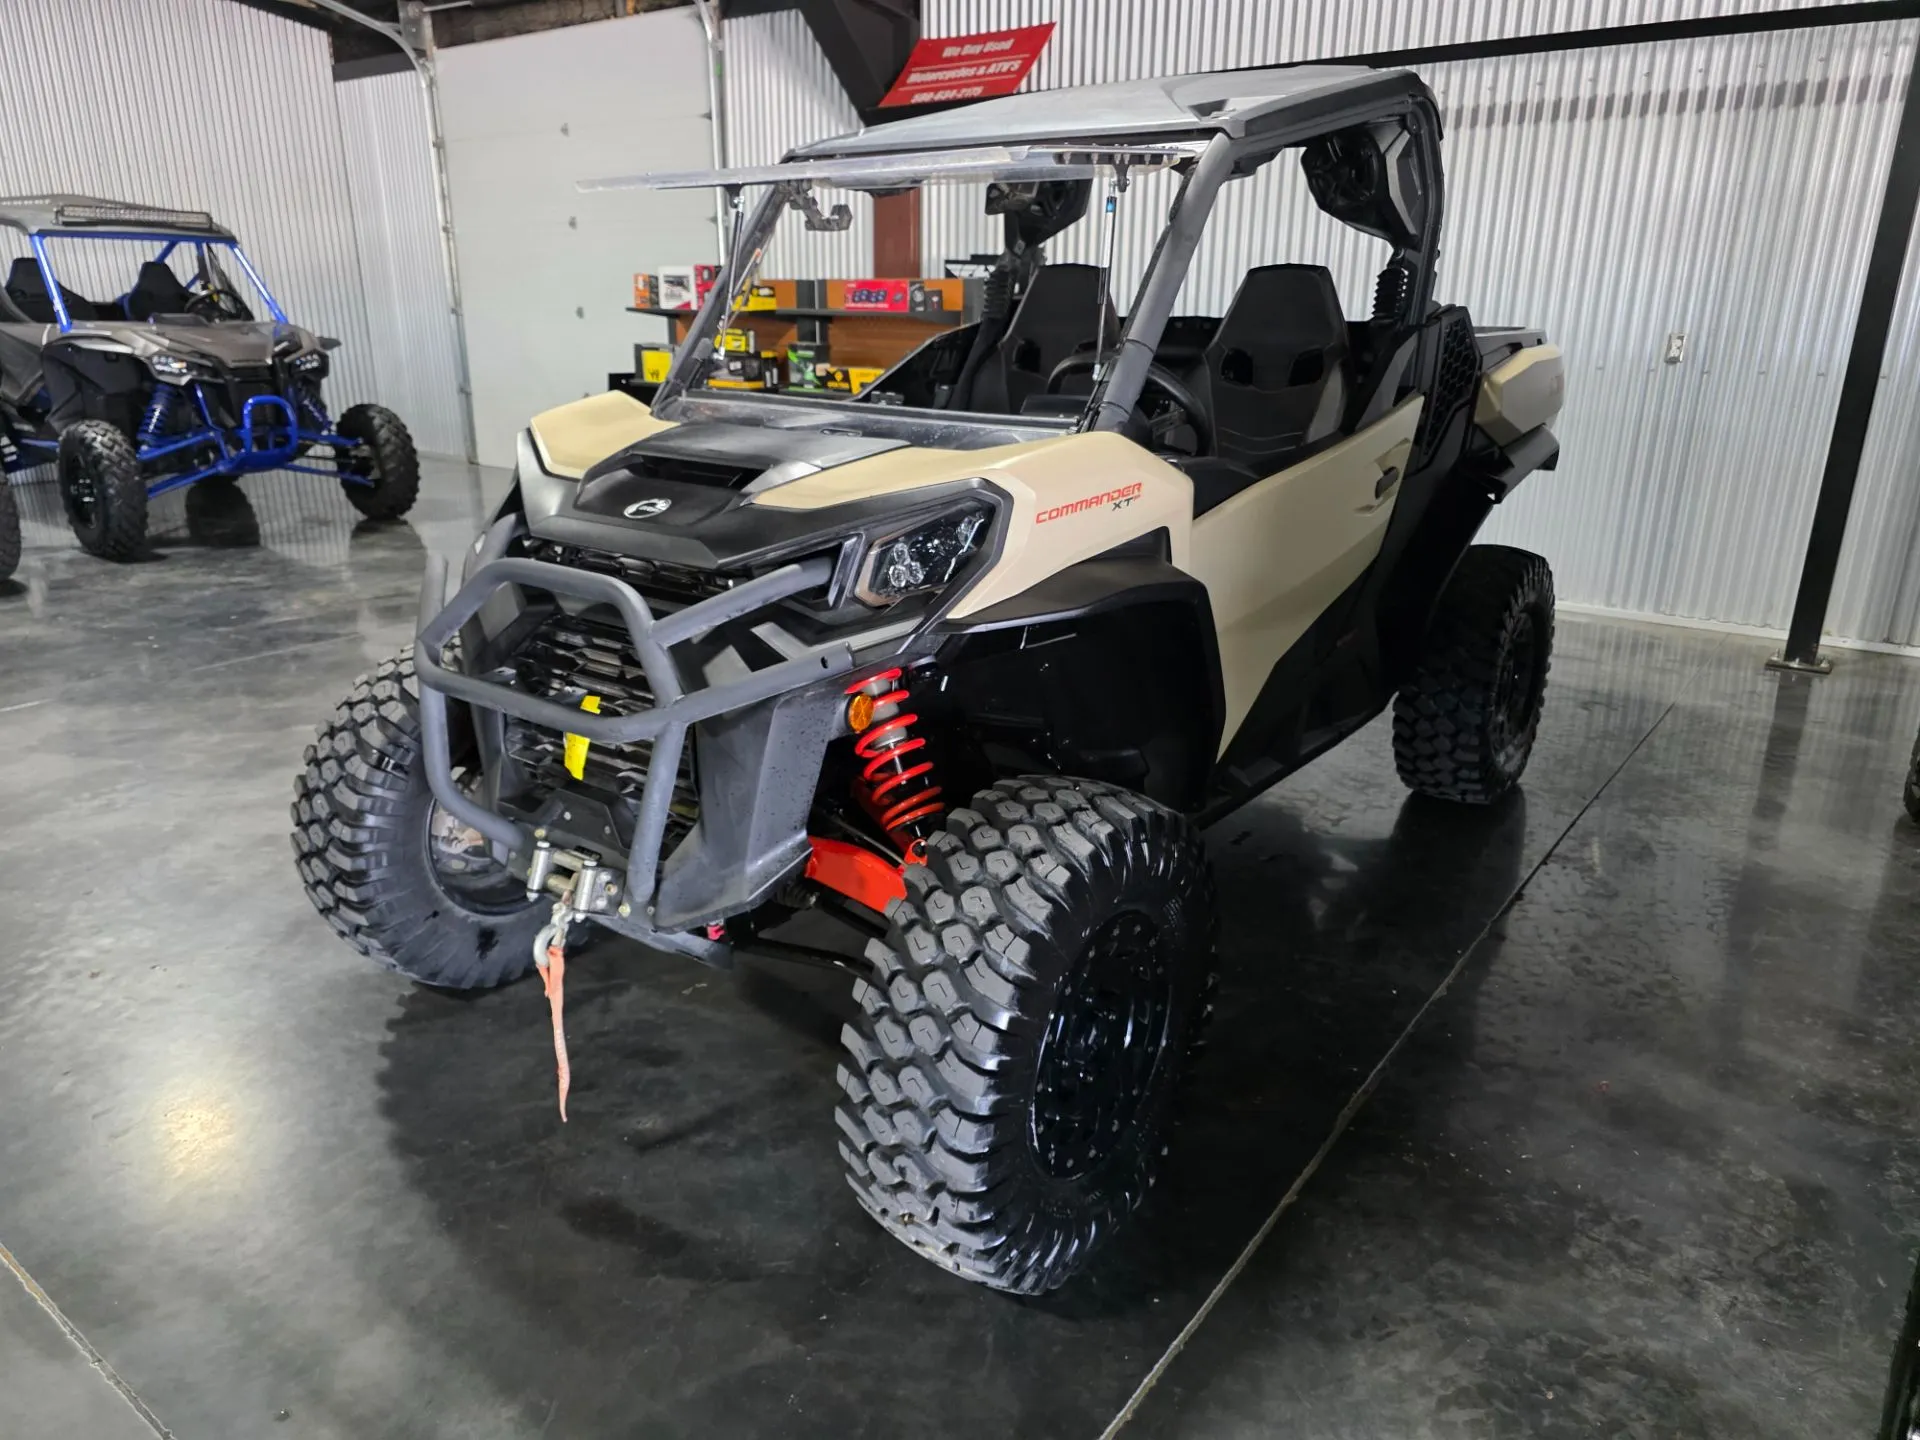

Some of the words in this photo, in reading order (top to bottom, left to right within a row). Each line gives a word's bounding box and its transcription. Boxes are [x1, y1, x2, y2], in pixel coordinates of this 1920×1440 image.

[983, 38, 1015, 53] Used
[906, 66, 977, 84] Motorcycles
[1036, 482, 1142, 524] COMMANDER
